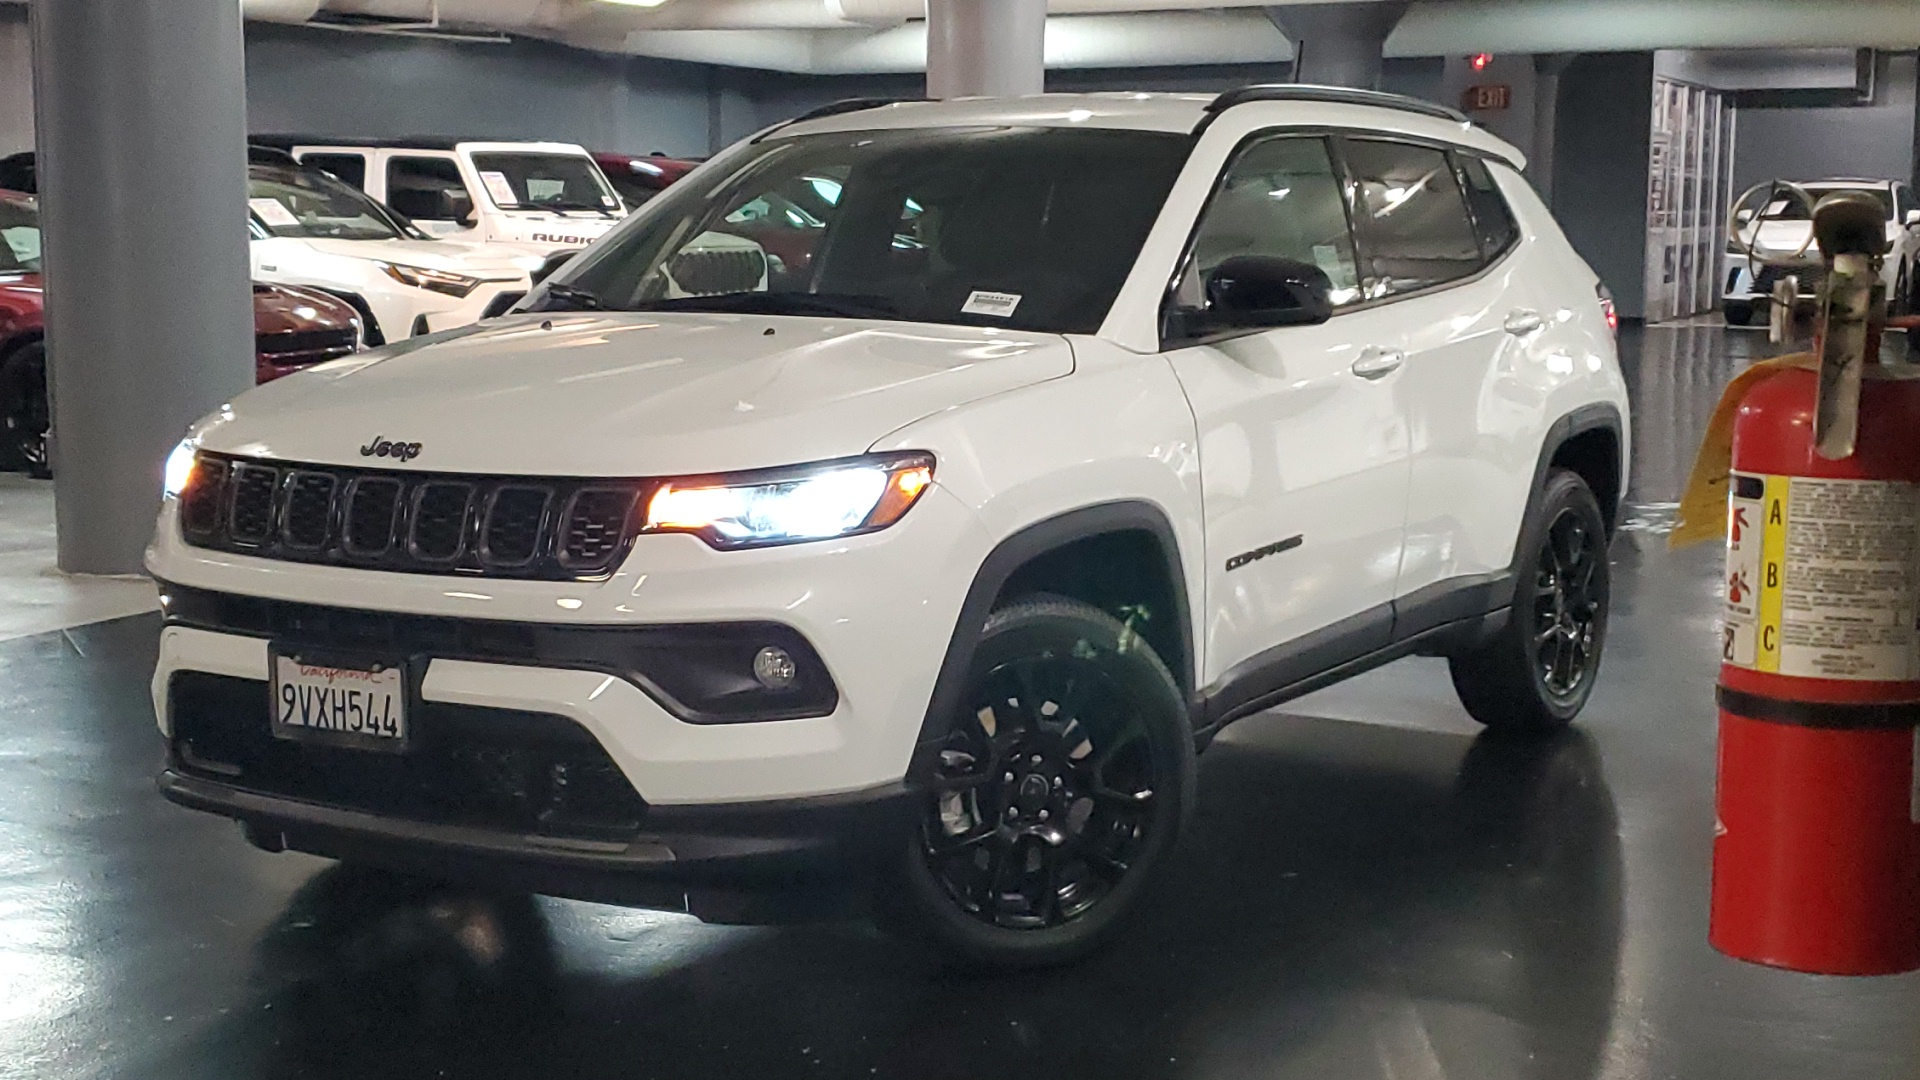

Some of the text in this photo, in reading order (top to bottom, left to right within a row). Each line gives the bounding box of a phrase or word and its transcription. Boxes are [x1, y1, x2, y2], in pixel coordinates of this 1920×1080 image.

[360, 435, 422, 462] Jeep
[1769, 498, 1782, 526] A
[1767, 562, 1778, 588] B
[1763, 625, 1774, 652] C
[282, 683, 398, 737] 9VXH544
